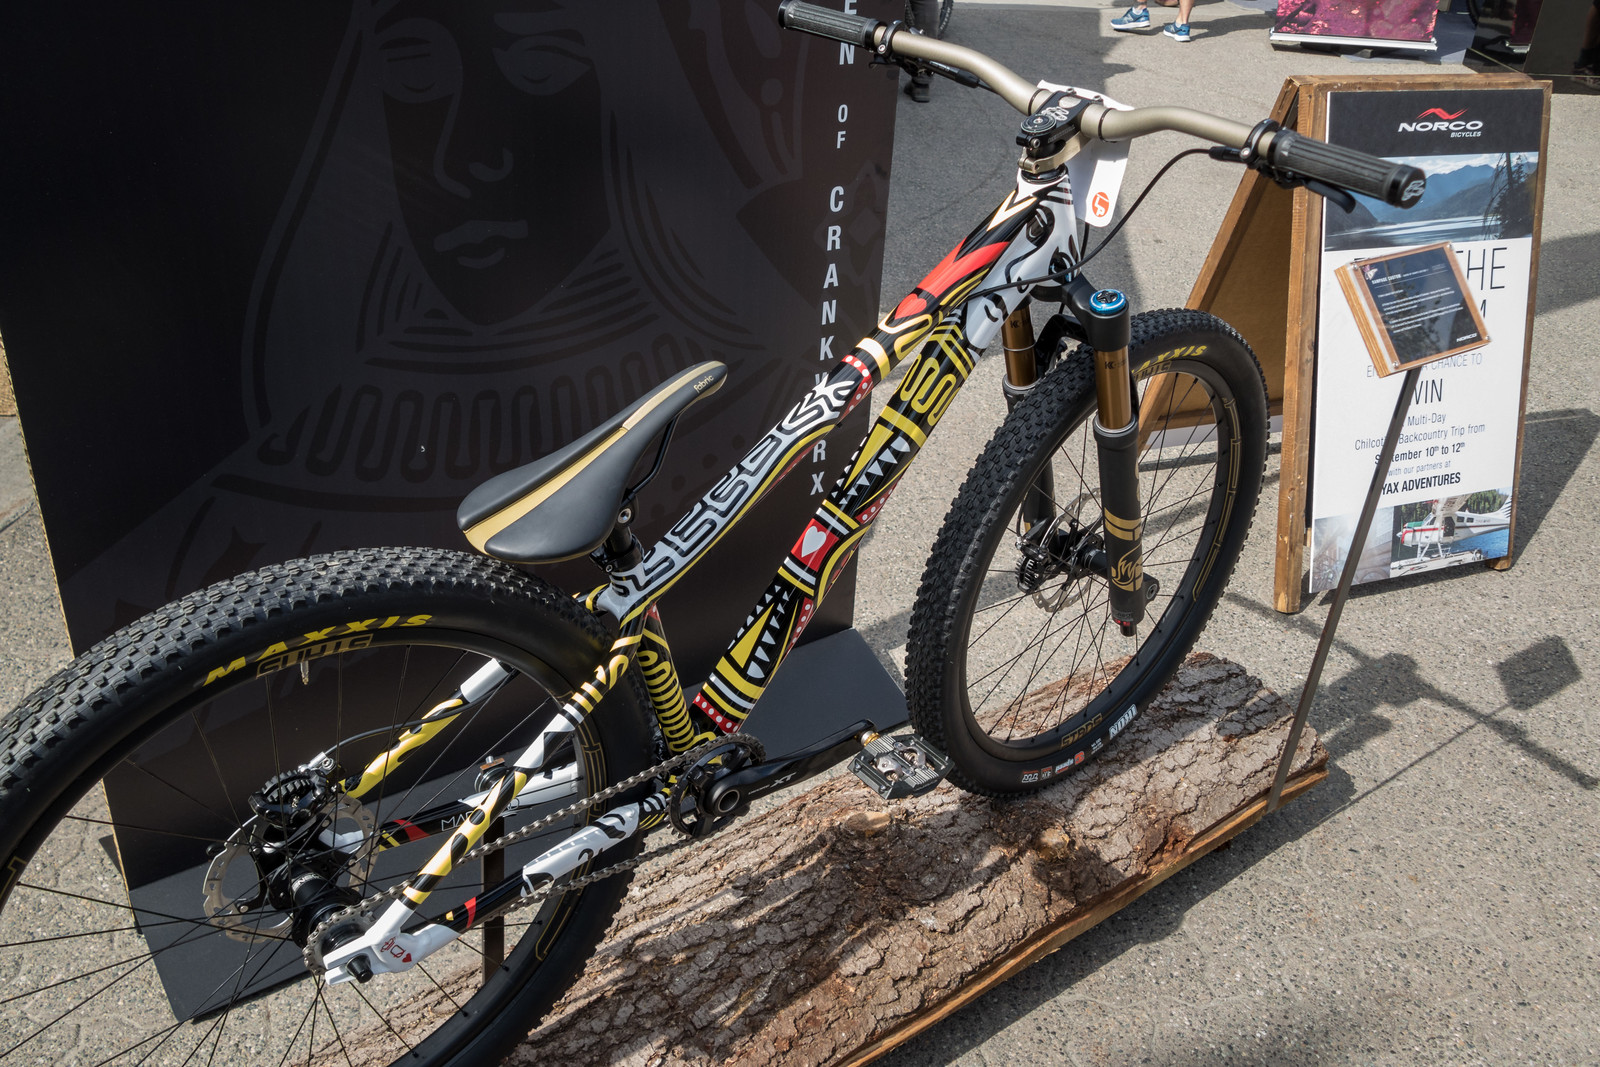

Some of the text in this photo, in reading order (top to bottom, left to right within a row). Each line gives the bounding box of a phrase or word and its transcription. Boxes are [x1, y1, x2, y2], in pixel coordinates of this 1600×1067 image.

[836, 104, 848, 149] OF
[1398, 120, 1483, 132] NORCO
[1456, 247, 1507, 290] HE
[810, 185, 845, 496] CRANKRX
[1131, 345, 1208, 374] AXXIS
[1431, 354, 1468, 371] CHANCE
[1471, 353, 1483, 366] TO
[693, 375, 714, 393] fabric
[1407, 412, 1447, 426] Multi-Day
[1354, 423, 1486, 451] Chilcot Backcountry Trip from
[1374, 441, 1466, 465] Stember 10th to 12th
[1388, 459, 1451, 477] with our partners at
[1381, 471, 1461, 496] YAX ADVENTURES
[201, 614, 433, 687] MAXXIS
